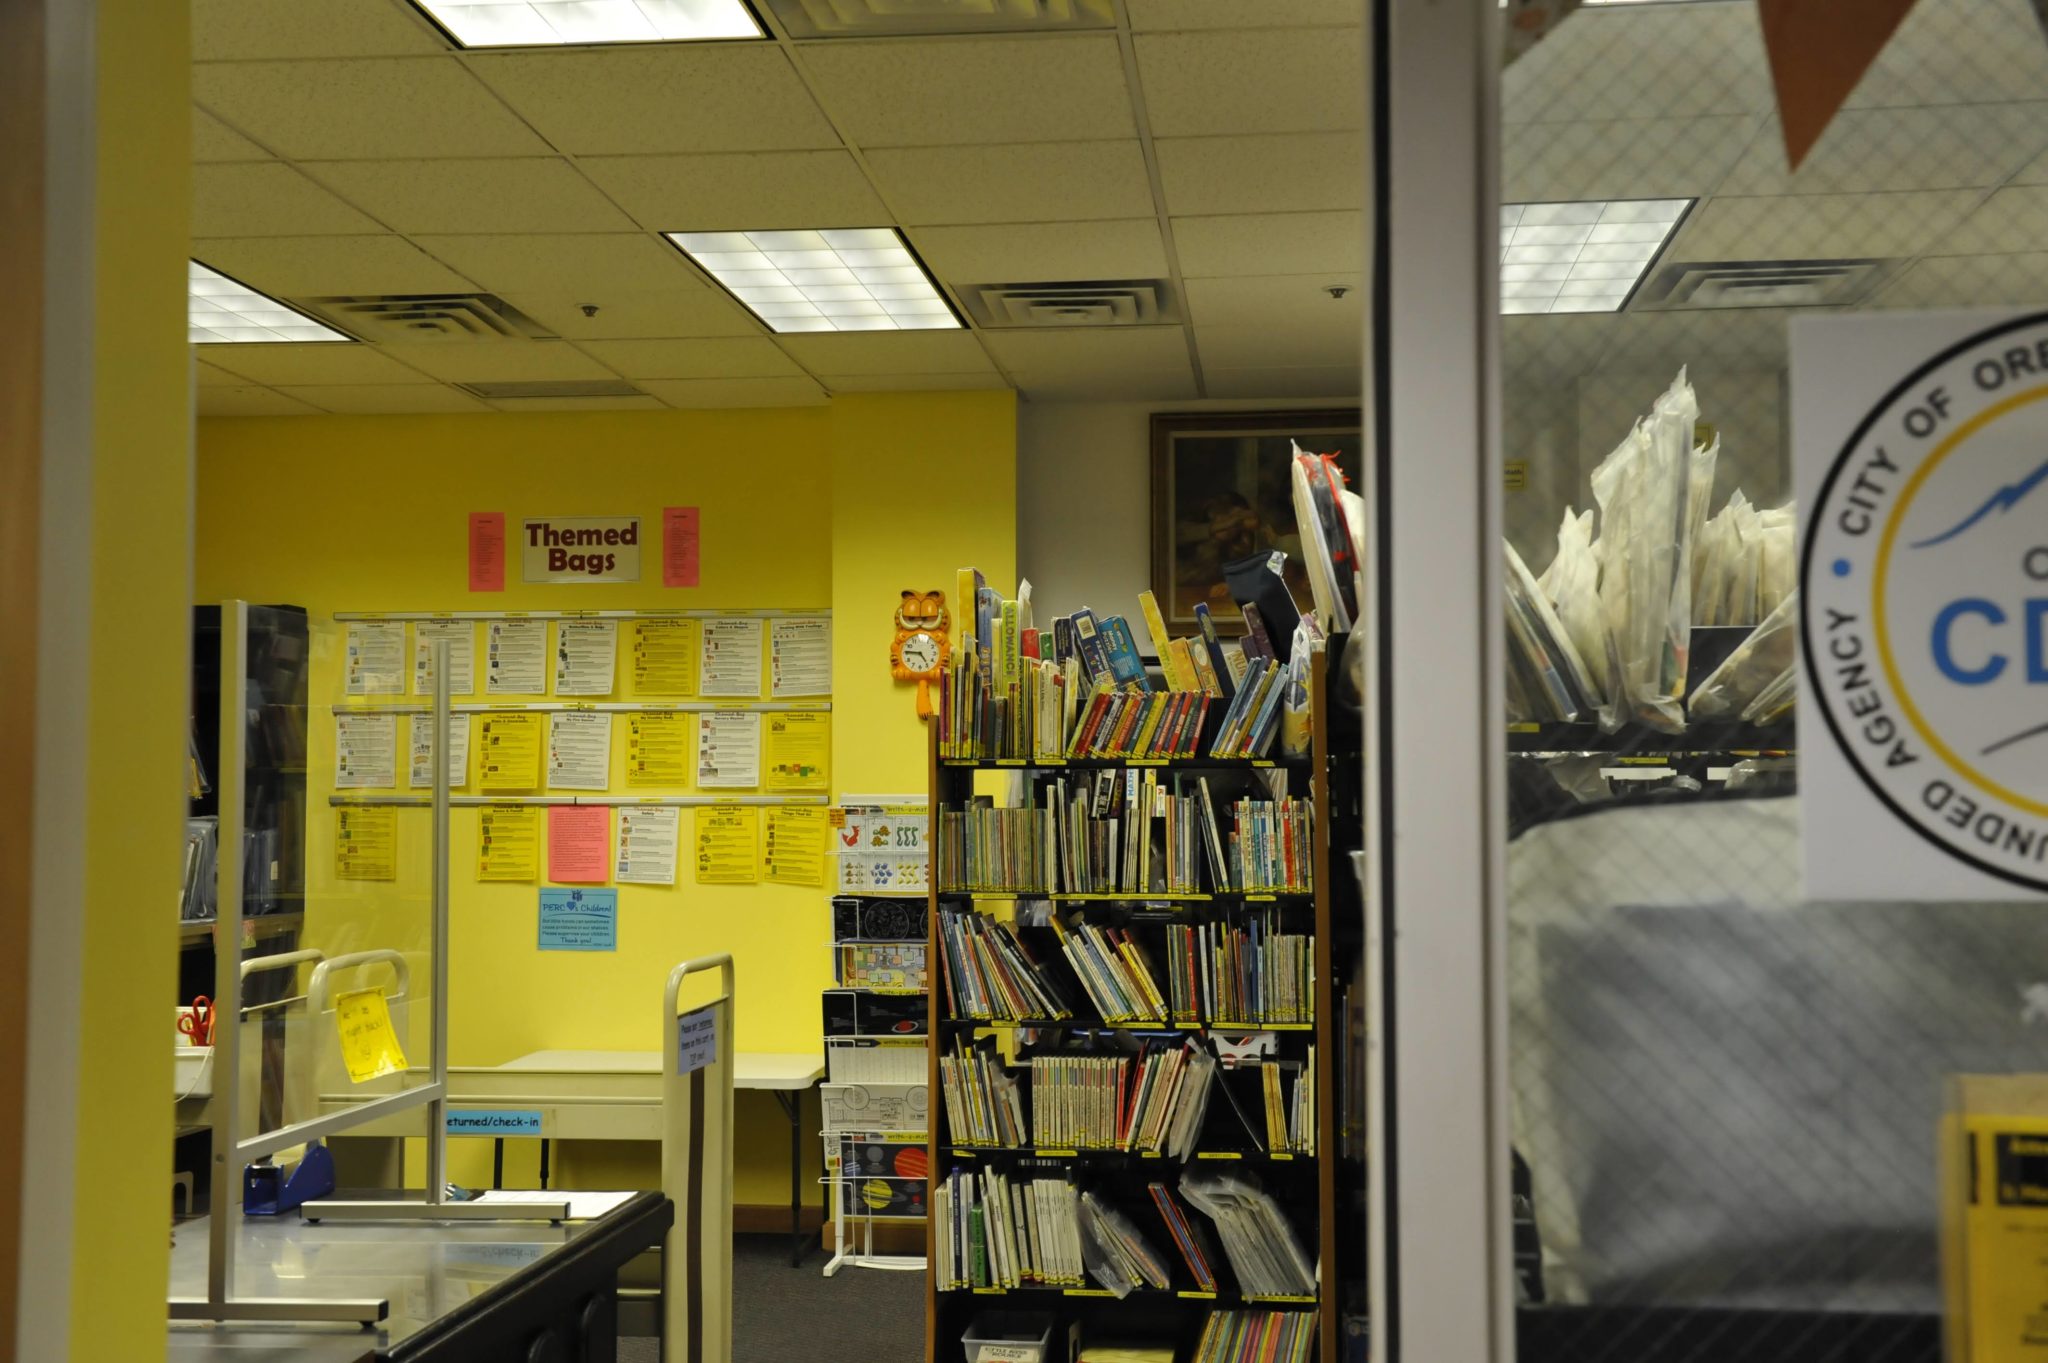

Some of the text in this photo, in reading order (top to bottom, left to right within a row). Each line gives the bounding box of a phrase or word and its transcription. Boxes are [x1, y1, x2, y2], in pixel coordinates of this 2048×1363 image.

[1839, 446, 1898, 536] CITY
[1902, 387, 1954, 441] OF
[526, 521, 638, 547] Themed
[548, 548, 616, 575] Bags
[1826, 607, 1920, 769] AGENCY
[542, 903, 565, 911] PERC
[580, 904, 612, 912] Children!
[446, 1116, 539, 1127] eturned/check-in
